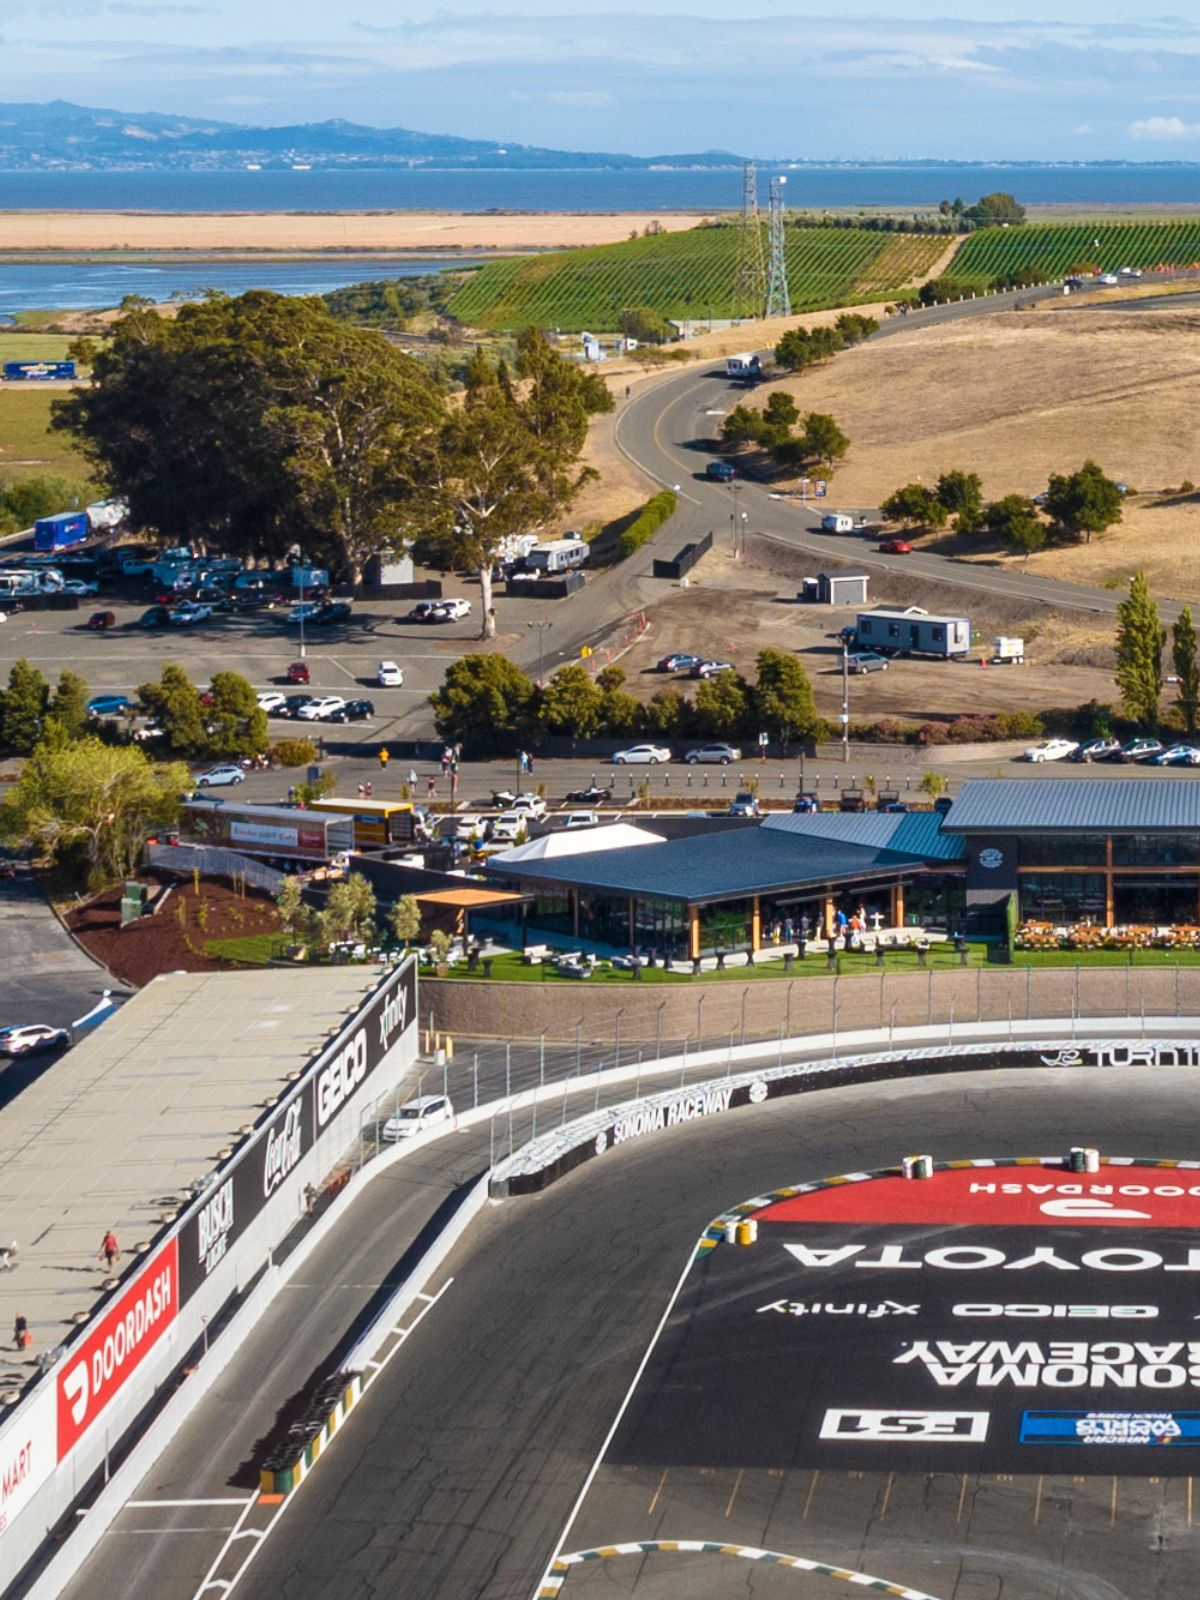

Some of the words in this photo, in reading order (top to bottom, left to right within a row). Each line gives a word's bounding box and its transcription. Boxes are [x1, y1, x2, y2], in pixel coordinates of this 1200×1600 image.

[379, 983, 408, 1051] xfinity
[318, 1028, 367, 1126] GEICO
[1088, 1048, 1179, 1067] TURN
[614, 1110, 665, 1145] SONOMA
[667, 1087, 734, 1126] RACEWAY
[198, 1177, 234, 1264] BUSCH
[93, 1266, 171, 1396] DOORDASH
[757, 1299, 921, 1318] xfinity
[952, 1303, 1160, 1318] GEICO
[836, 1415, 975, 1436] FS1
[1083, 1436, 1150, 1444] NASCAR
[2, 1440, 32, 1504] MART
